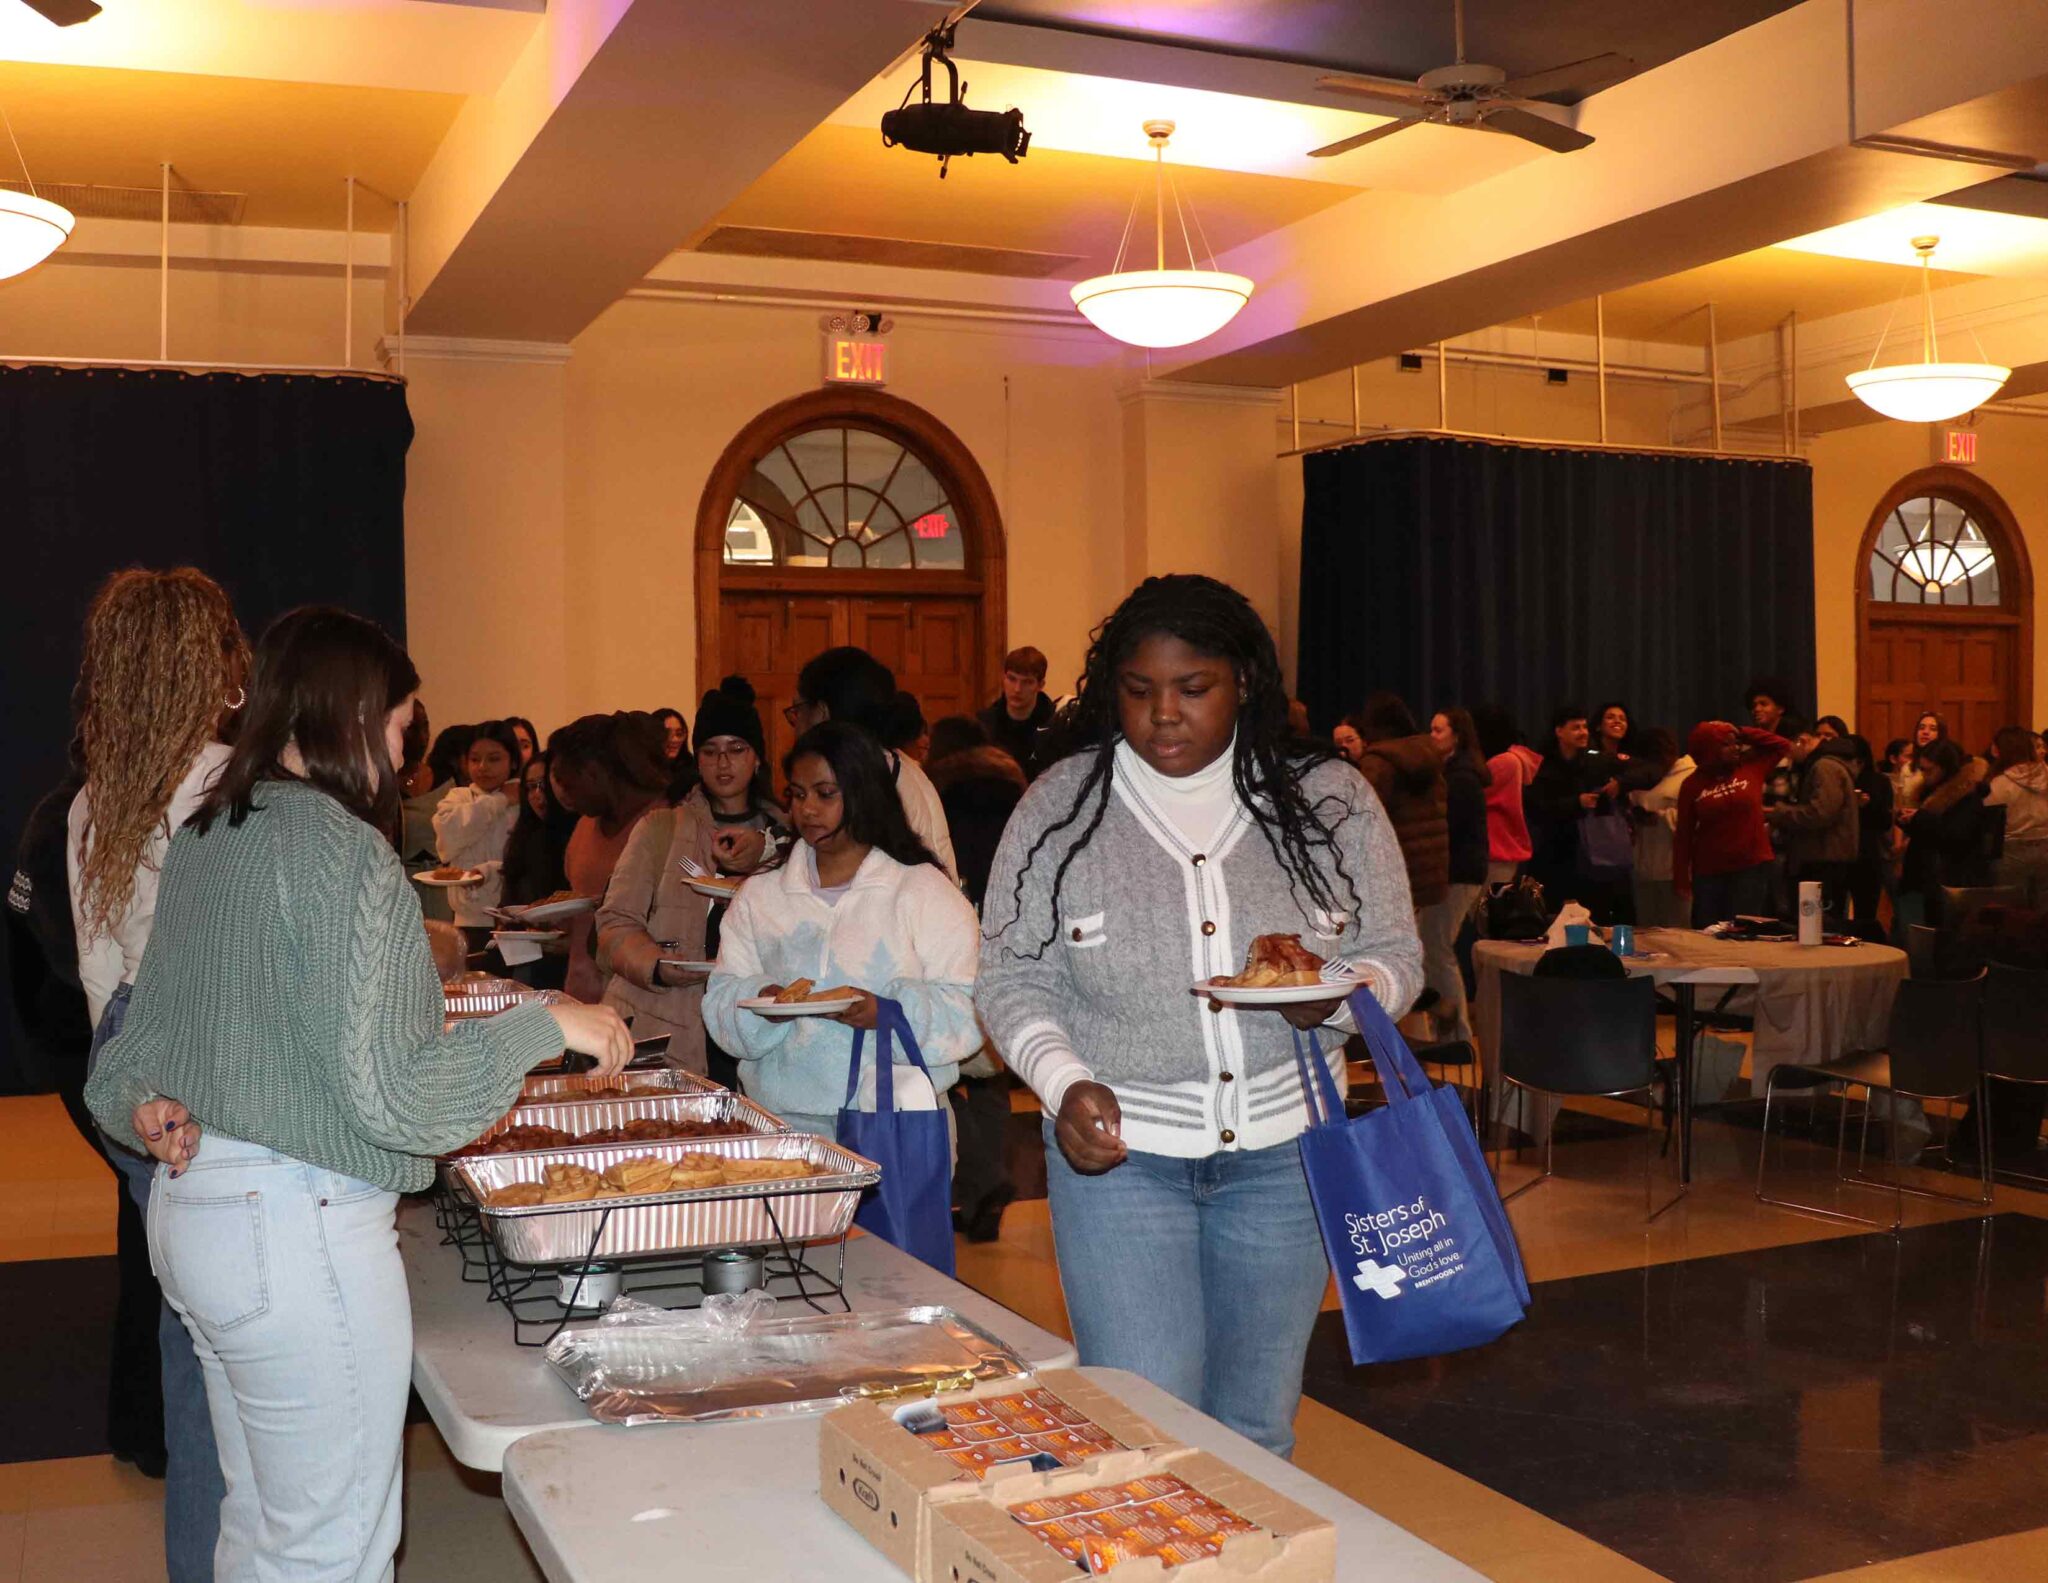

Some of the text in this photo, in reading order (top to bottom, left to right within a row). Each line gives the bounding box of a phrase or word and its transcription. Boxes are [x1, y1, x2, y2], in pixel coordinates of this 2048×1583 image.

[836, 341, 885, 381] EXIT
[1949, 432, 1977, 462] EXIT
[1344, 1195, 1425, 1234] Sisters of
[1351, 1209, 1446, 1256] St. Joseph
[1397, 1237, 1454, 1266] Uniting all in
[1408, 1252, 1460, 1278] God's love
